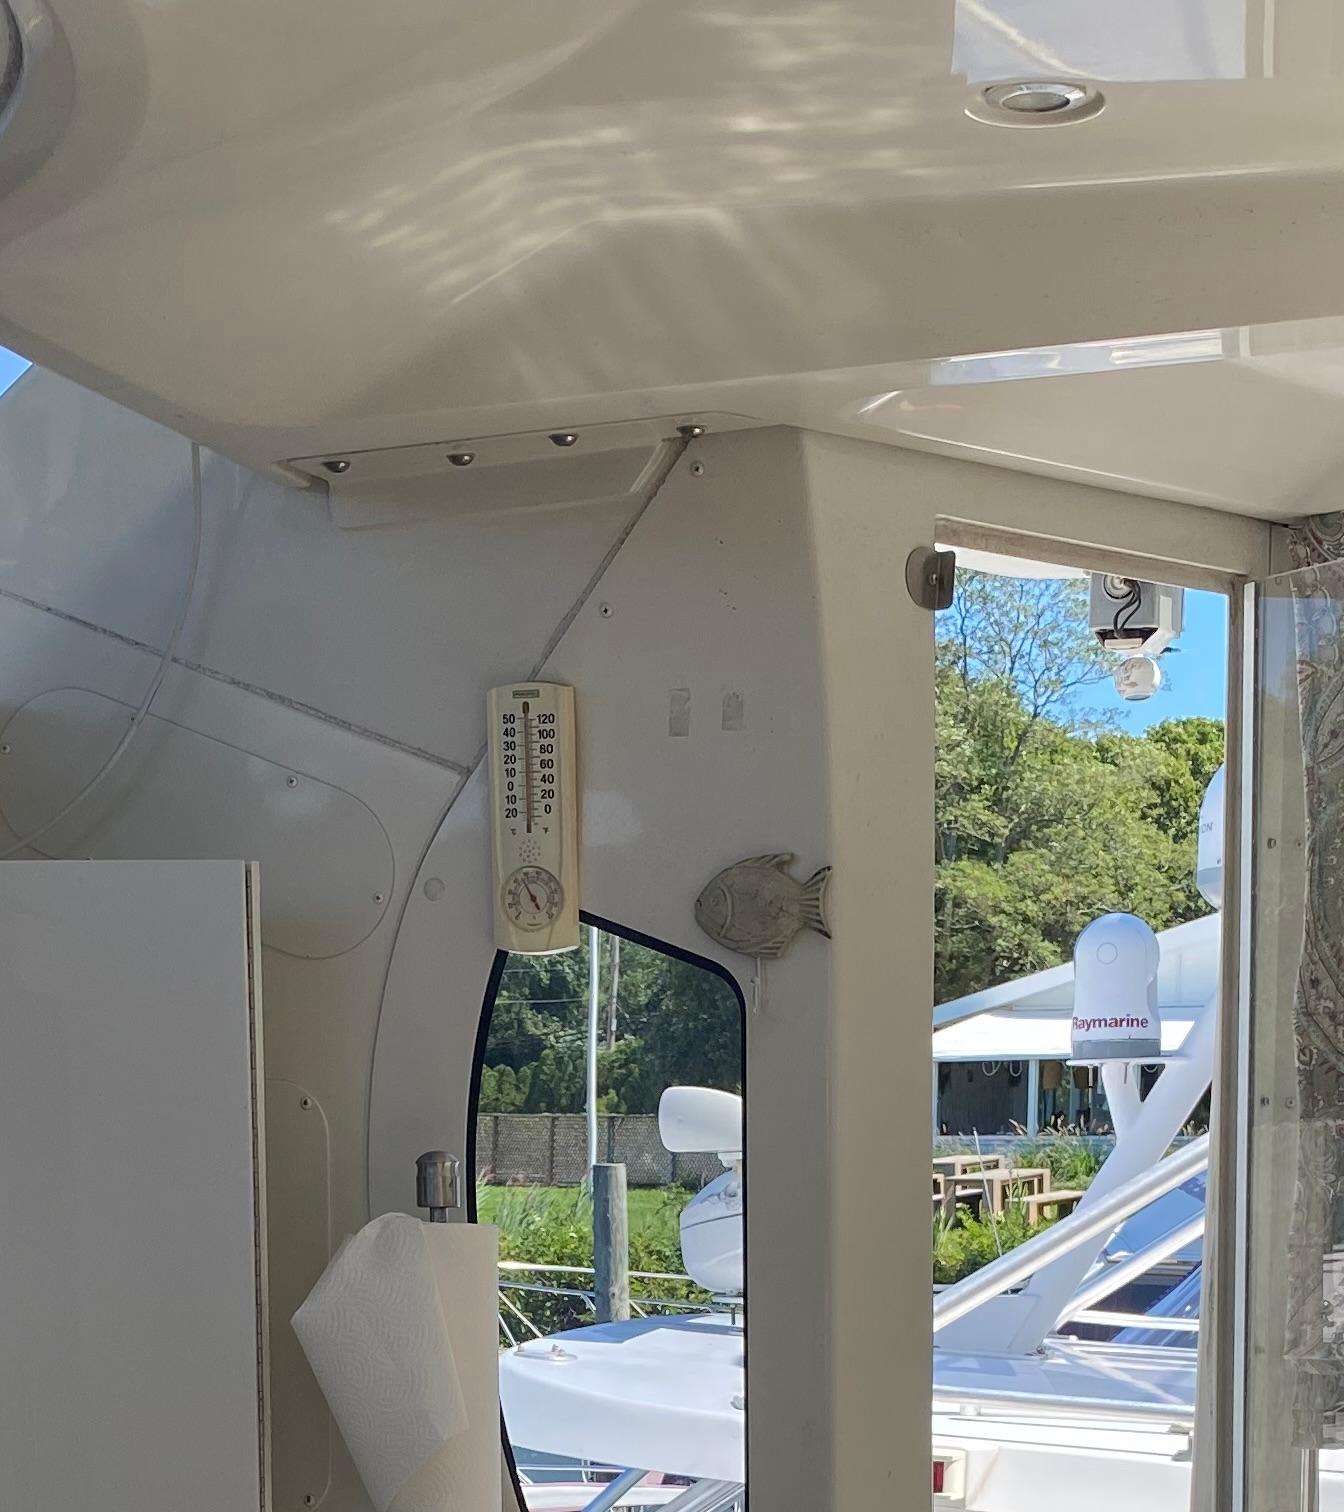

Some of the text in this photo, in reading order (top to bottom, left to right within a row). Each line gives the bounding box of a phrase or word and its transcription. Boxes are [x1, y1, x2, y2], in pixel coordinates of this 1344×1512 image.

[502, 713, 516, 725] 50
[536, 713, 555, 724] 120
[502, 727, 516, 738] 40
[537, 728, 556, 740] 100
[503, 741, 516, 752] 30
[539, 743, 554, 754] 80
[503, 754, 517, 765] 20
[539, 759, 554, 769] 60
[504, 768, 516, 778] 10
[540, 774, 555, 784] 40
[507, 781, 514, 792] 0
[505, 794, 517, 806] 10
[540, 789, 555, 800] 20
[505, 808, 518, 819] 20
[544, 804, 552, 815] 0
[1072, 1013, 1149, 1032] Raymarine
